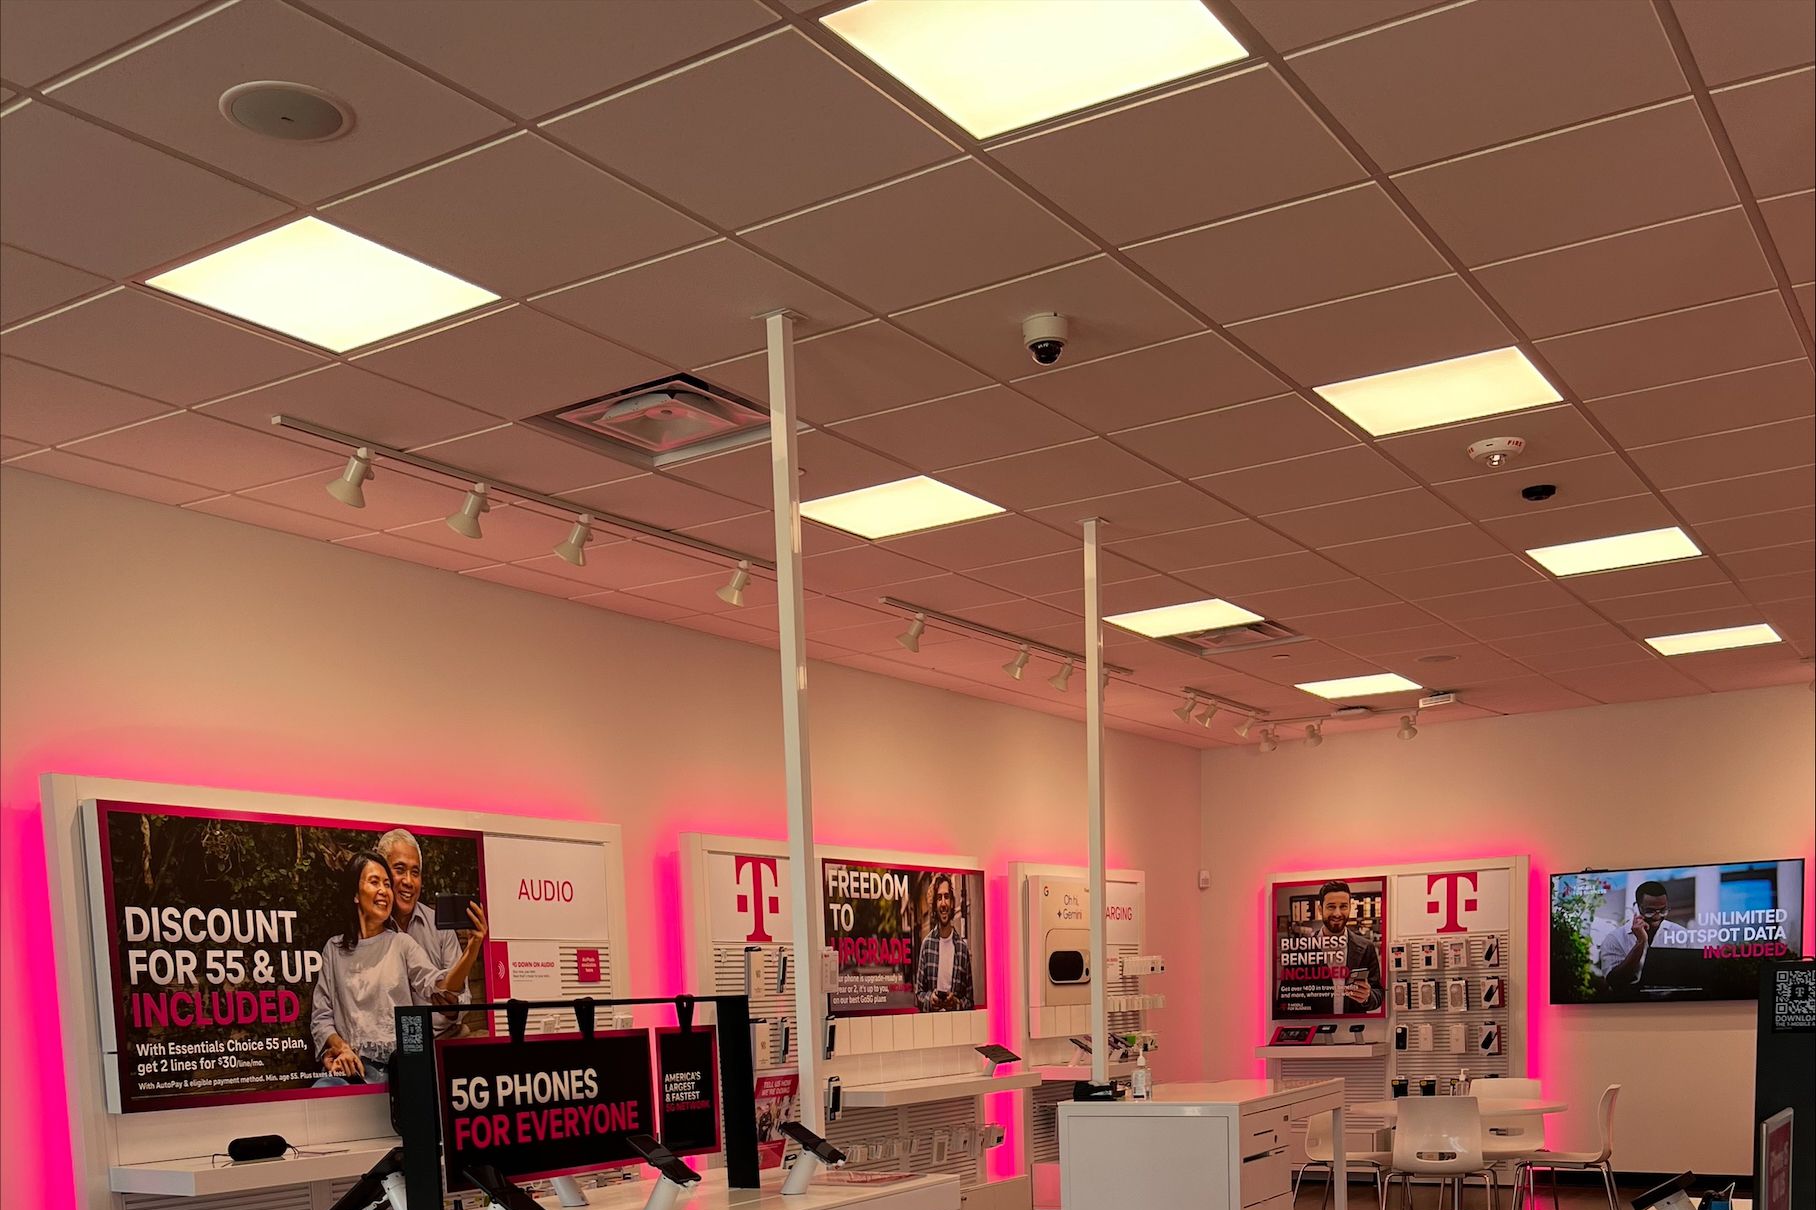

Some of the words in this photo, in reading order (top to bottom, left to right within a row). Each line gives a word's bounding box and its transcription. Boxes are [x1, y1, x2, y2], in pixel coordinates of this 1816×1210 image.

[518, 878, 574, 903] AUDIO
[828, 869, 909, 901] FREEDOM
[829, 903, 855, 932] TO
[1105, 906, 1133, 921] ARGING
[1698, 908, 1788, 927] UNLIMITED
[124, 906, 298, 944] DISCOUNT
[1281, 935, 1348, 951] BUSINESS
[1663, 928, 1741, 945] HOTSPOT
[1743, 925, 1787, 942] DATA
[1281, 951, 1345, 967] BENEFITS
[1703, 943, 1788, 960] INCLUDED
[128, 949, 198, 986] FOR
[205, 950, 246, 985] 55
[252, 949, 275, 984] &
[281, 950, 323, 984] UP
[1281, 966, 1351, 981] INCLUDED
[844, 974, 860, 984] phone
[131, 989, 300, 1028] INCLUDED
[1775, 1014, 1816, 1022] DOWNLOA
[136, 1043, 166, 1057] With
[168, 1040, 225, 1055] Essentials
[226, 1038, 264, 1053] Choice
[265, 1038, 280, 1050] 55
[281, 1036, 308, 1052] plan,
[137, 1060, 159, 1076] get
[160, 1059, 169, 1072] 2
[170, 1058, 198, 1072] lines
[199, 1057, 216, 1070] for
[138, 1081, 155, 1090] With
[156, 1080, 183, 1090] AutoPay
[183, 1079, 190, 1088] &
[190, 1078, 213, 1088] eligible
[213, 1077, 240, 1087] payment
[240, 1074, 265, 1084] method.
[265, 1073, 279, 1082] Min.
[279, 1074, 290, 1082] age
[300, 1071, 312, 1079] Plus
[664, 1071, 702, 1083] AMERICA'S
[451, 1075, 490, 1111] 5G
[495, 1068, 599, 1108] PHONES
[664, 1081, 696, 1093] LARGEST
[665, 1093, 671, 1103] &
[671, 1091, 701, 1102] FASTEST
[454, 1114, 511, 1150] FOR
[516, 1100, 639, 1144] EVERYONE
